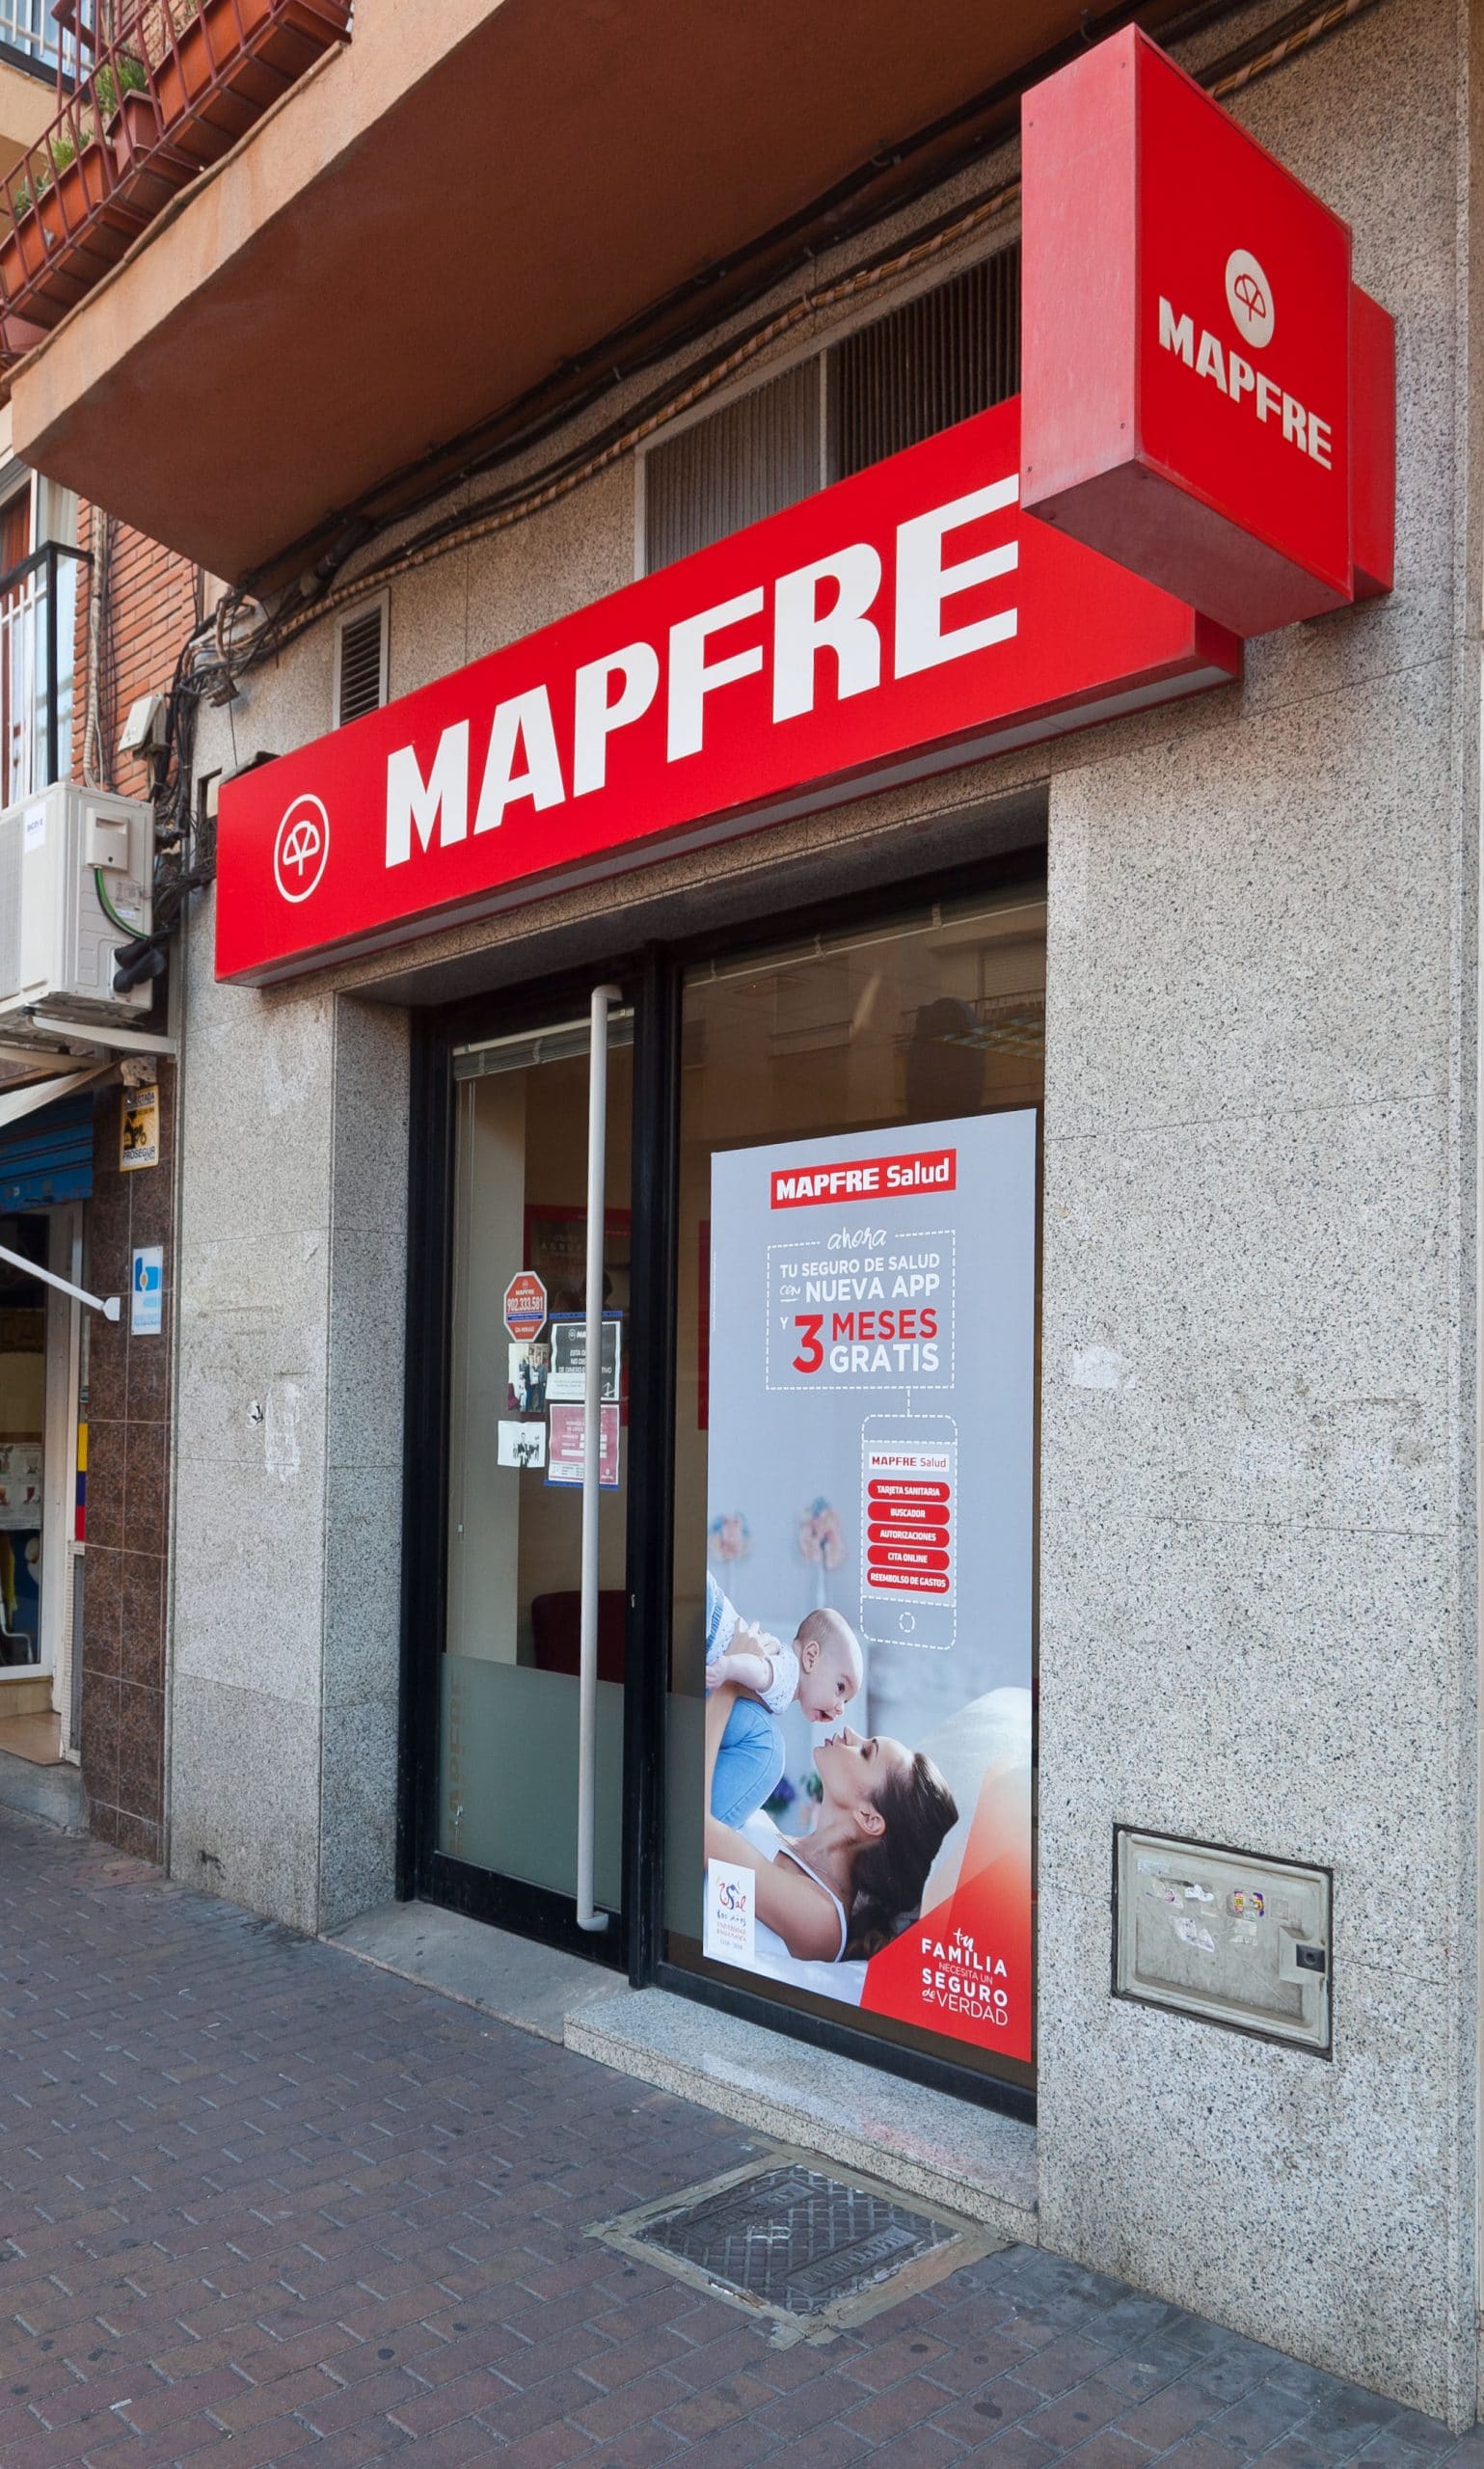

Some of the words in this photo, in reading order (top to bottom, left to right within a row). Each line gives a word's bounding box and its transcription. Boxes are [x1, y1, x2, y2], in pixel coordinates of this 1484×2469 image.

[1159, 294, 1332, 471] MAPFRE
[386, 474, 1018, 869] MAPFRE
[776, 1167, 879, 1201] MAPFRE
[886, 1157, 950, 1188] Salud
[827, 1226, 887, 1251] ahora
[779, 1264, 797, 1278] TU
[801, 1259, 859, 1277] SEGURO
[864, 1257, 884, 1272] DE
[888, 1253, 940, 1271] SALUD
[806, 1277, 884, 1303] NUEVA
[891, 1273, 940, 1298] APP
[779, 1316, 789, 1330] Y
[792, 1314, 824, 1373] 3
[832, 1308, 938, 1342] MESES
[829, 1342, 939, 1373] GRATIS
[872, 1456, 917, 1467] MAPFRE
[920, 1457, 947, 1468] Salud
[877, 1485, 904, 1496] TARJETA
[904, 1486, 940, 1497] SANITARIA
[890, 1507, 926, 1518] BUSCADOR
[879, 1530, 936, 1541] AUTORIZACIONES
[887, 1552, 903, 1561] CITA
[903, 1553, 929, 1563] ONLINE
[870, 1573, 909, 1584] REEMBOLSO
[909, 1576, 919, 1585] DE
[919, 1577, 946, 1587] GASTOS
[953, 1927, 974, 1952] tu
[921, 1938, 1008, 1977] FAMILIA
[938, 1962, 979, 1980] NECESITA
[980, 1973, 993, 1985] UN
[922, 1967, 1008, 2007] SEGURO
[922, 1988, 935, 1999] de
[936, 1990, 1008, 2026] VERDAD
